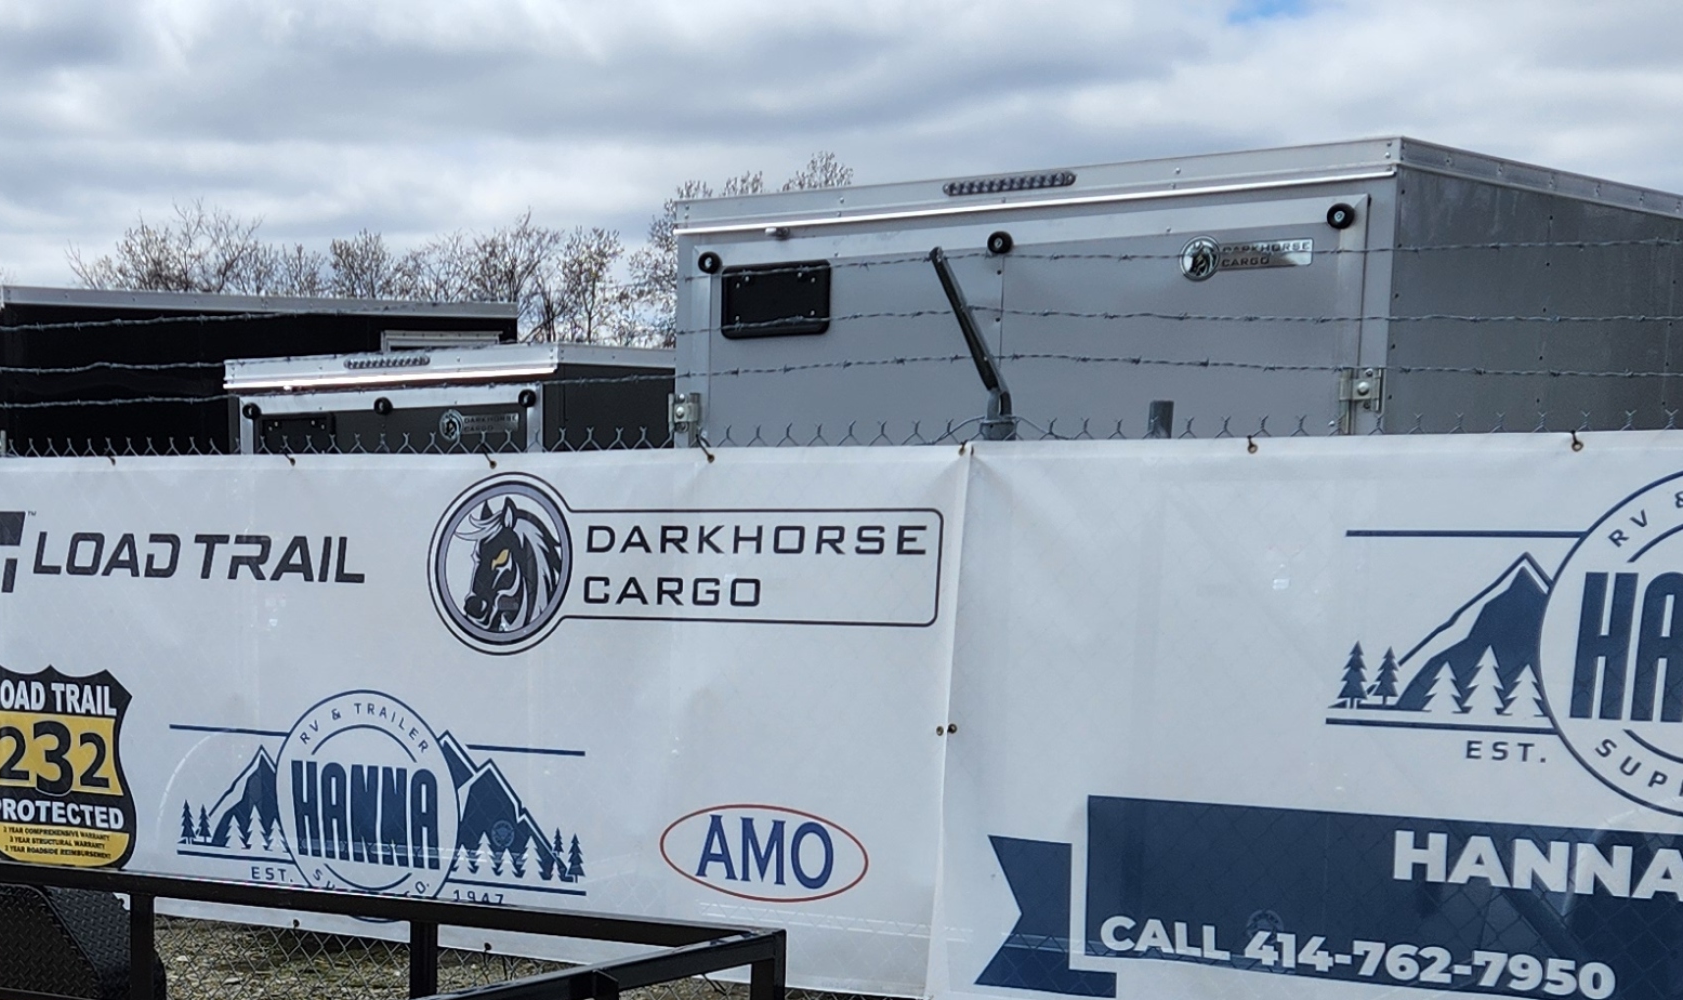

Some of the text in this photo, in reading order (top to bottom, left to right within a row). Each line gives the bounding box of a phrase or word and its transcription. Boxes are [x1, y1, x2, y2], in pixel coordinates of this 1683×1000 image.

[1221, 256, 1270, 267] CARGO
[585, 523, 928, 556] DARKHORSE
[1607, 508, 1649, 548] RV
[32, 530, 366, 584] LOAD TRAIL
[582, 576, 762, 608] CARGO
[50, 682, 117, 717] TRAIL
[299, 702, 430, 754] RV & TRAILER
[1465, 739, 1548, 764] EST.
[1594, 738, 1683, 797] SUP
[9, 826, 24, 834] YEAR
[290, 759, 441, 871] HANNA
[15, 836, 30, 844] YEAR
[74, 841, 105, 850] WARRANTY
[694, 814, 835, 890] AMO
[250, 866, 294, 883] EST.
[1392, 829, 1683, 902] HANNA
[1100, 915, 1617, 1000] CALL 414-762-7950
